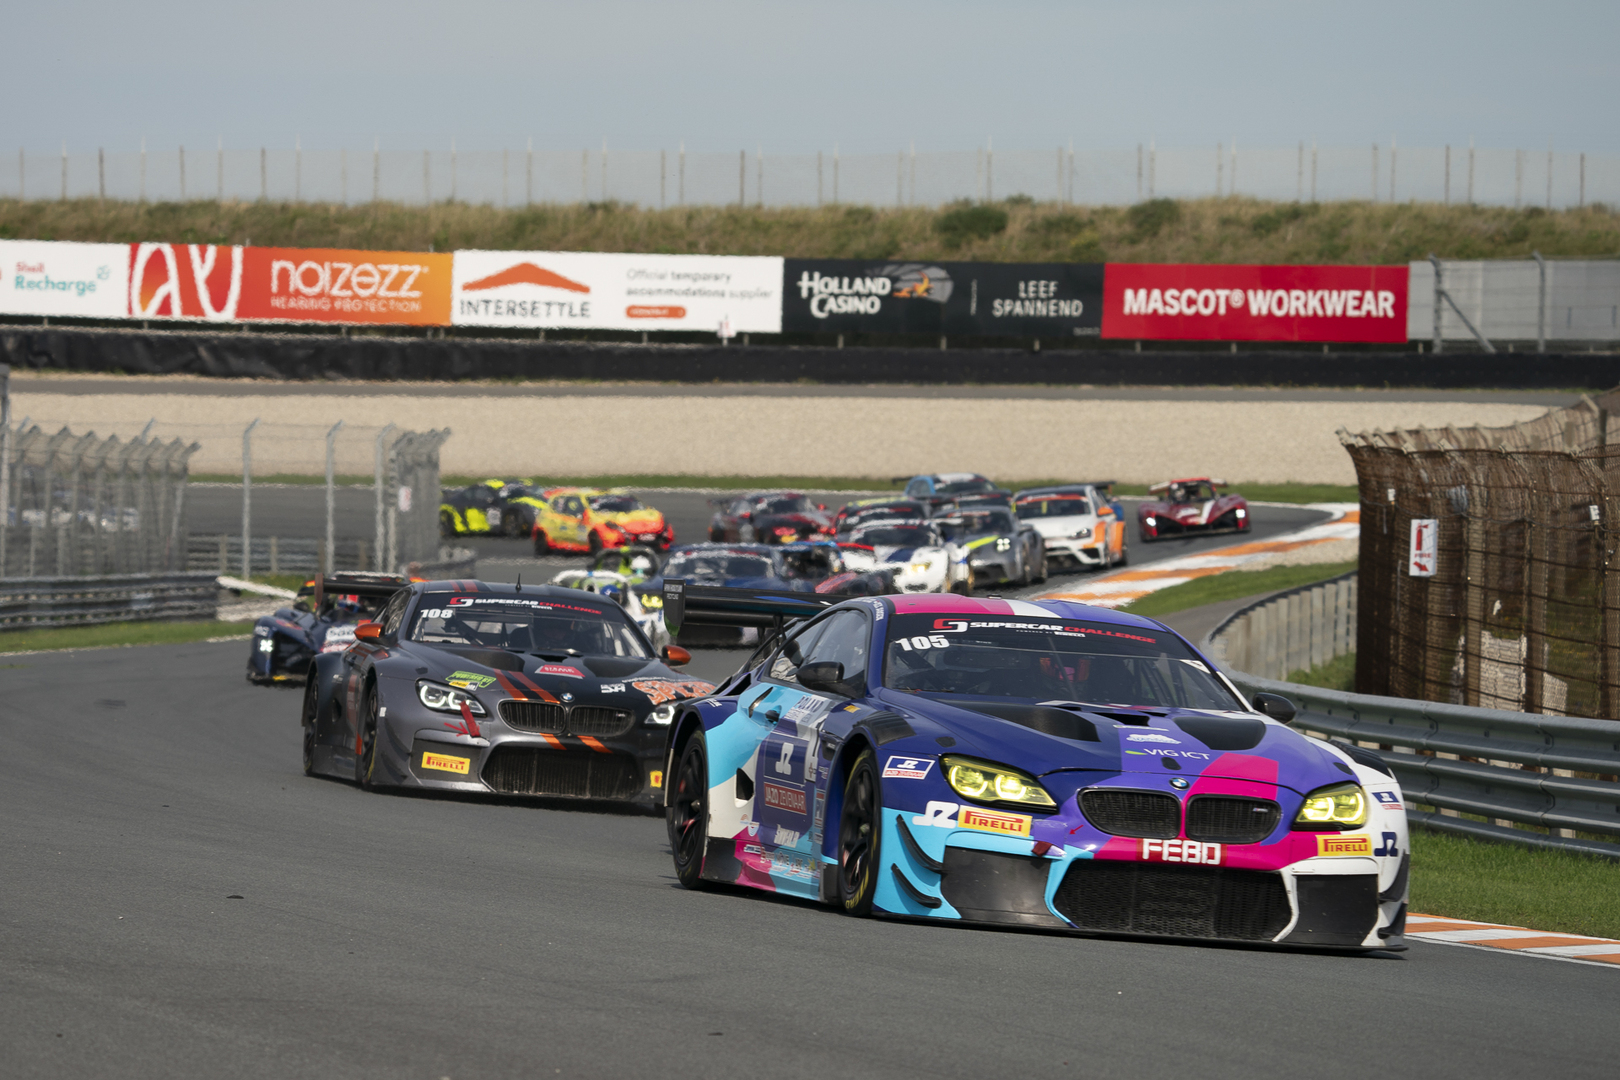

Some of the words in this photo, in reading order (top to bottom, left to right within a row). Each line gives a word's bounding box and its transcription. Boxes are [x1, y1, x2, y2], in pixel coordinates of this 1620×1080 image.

[14, 274, 97, 297] Recharge
[671, 271, 731, 284] temporary
[797, 271, 892, 299] HOLLAND
[729, 287, 773, 301] supplier
[1018, 280, 1059, 298] LEEF
[271, 295, 331, 311] HEARING
[334, 297, 421, 313] PROTECTION
[459, 298, 591, 319] INTERSETTLE
[810, 294, 881, 319] CASINO
[992, 298, 1084, 318] SPANNEND
[1246, 289, 1396, 319] WORKWEAR
[420, 608, 454, 619] 108
[474, 598, 539, 607] SUPERCAR
[539, 601, 603, 616] CHALLENGE
[970, 621, 1064, 632] SUPERCAR
[1064, 626, 1157, 644] CHALLENGE
[895, 634, 950, 651] 105
[426, 755, 466, 771] PIRELLI
[1143, 747, 1180, 757] VIG
[1180, 750, 1211, 761] ICT
[765, 786, 779, 804] JAZO
[963, 809, 1025, 832] PIRELLI
[1142, 838, 1221, 865] FEBO
[1323, 837, 1368, 852] PIRELLI
